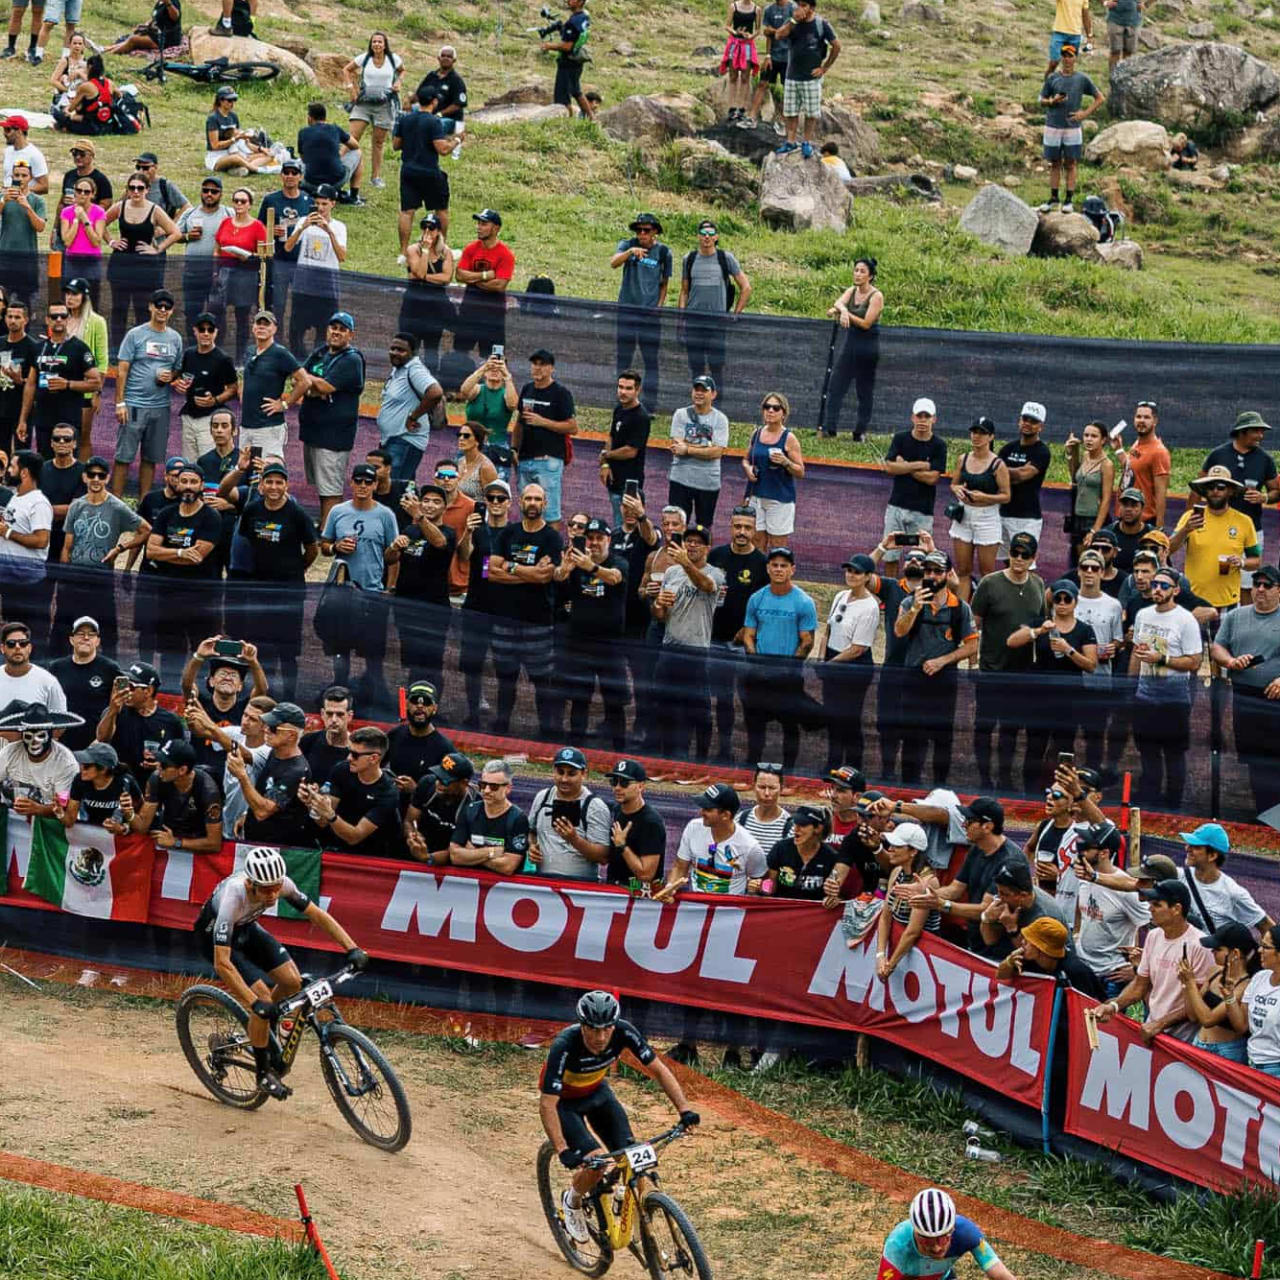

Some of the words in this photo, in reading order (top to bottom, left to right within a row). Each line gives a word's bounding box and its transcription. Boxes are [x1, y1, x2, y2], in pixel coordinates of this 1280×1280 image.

[381, 870, 759, 984] MOTUL
[311, 985, 329, 1002] 34
[808, 920, 1042, 1077] MOTUL
[632, 1149, 651, 1165] 24
